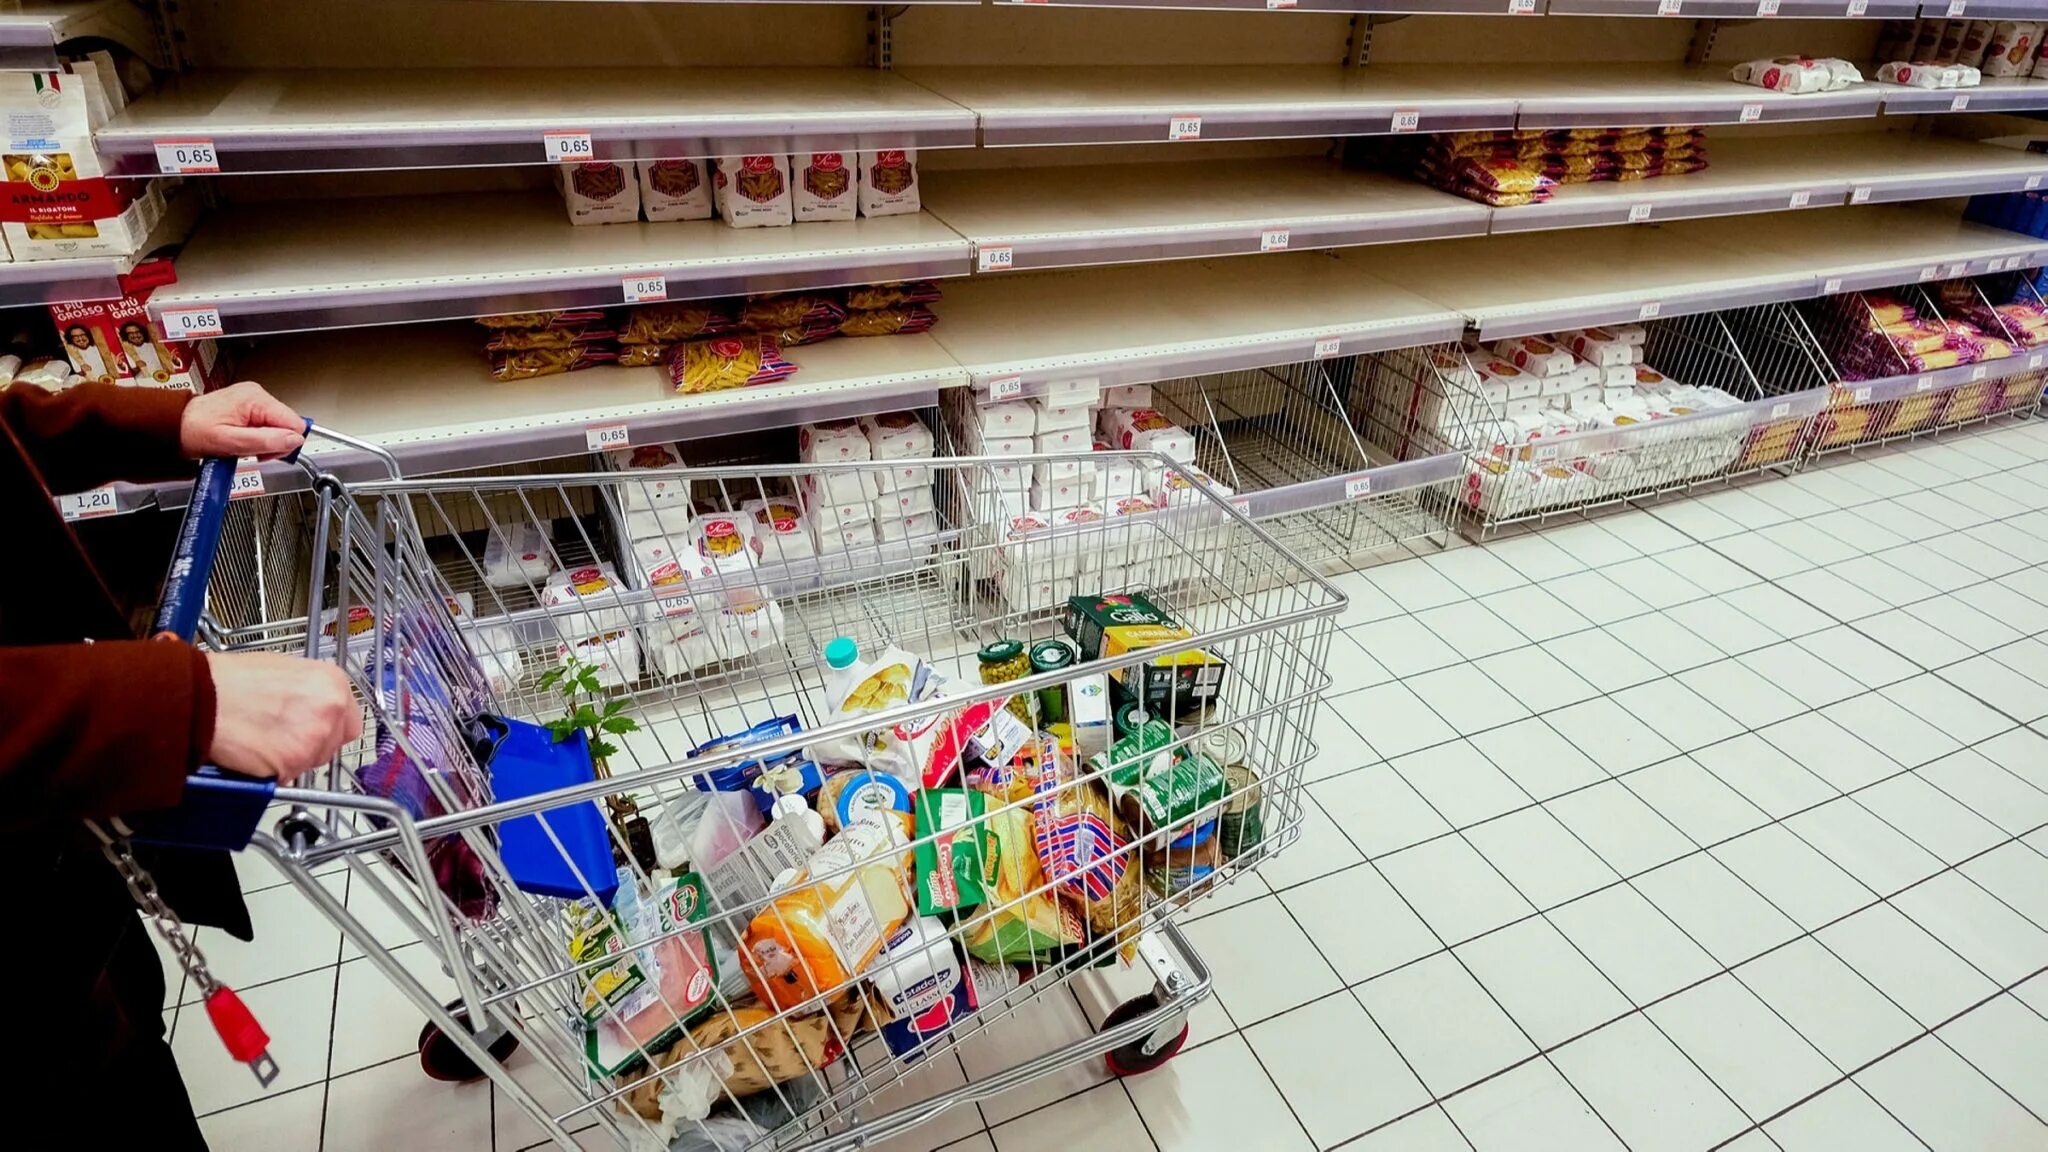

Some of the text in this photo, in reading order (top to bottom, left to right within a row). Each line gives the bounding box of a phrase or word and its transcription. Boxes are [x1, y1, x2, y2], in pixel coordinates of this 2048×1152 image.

[1400, 115, 1417, 126] 0,65
[1179, 122, 1199, 133] 0,65
[561, 140, 590, 154] 0,65
[176, 149, 213, 164] 0,65
[1270, 235, 1288, 245] 0,65
[989, 252, 1011, 264] 0,65
[637, 280, 663, 293] 0,65
[52, 305, 64, 315] IL
[57, 305, 103, 321] GROSSO
[107, 303, 119, 312] IL
[182, 314, 217, 329] 0,65
[1322, 341, 1339, 352] 0,65
[1000, 381, 1020, 393] 0,65
[600, 428, 626, 442] 0,65
[1353, 481, 1370, 492] 0,65
[77, 493, 111, 508] 1,20
[665, 596, 690, 608] 0,65
[1110, 611, 1159, 623] Gallo
[896, 970, 949, 1002] Notadoce
